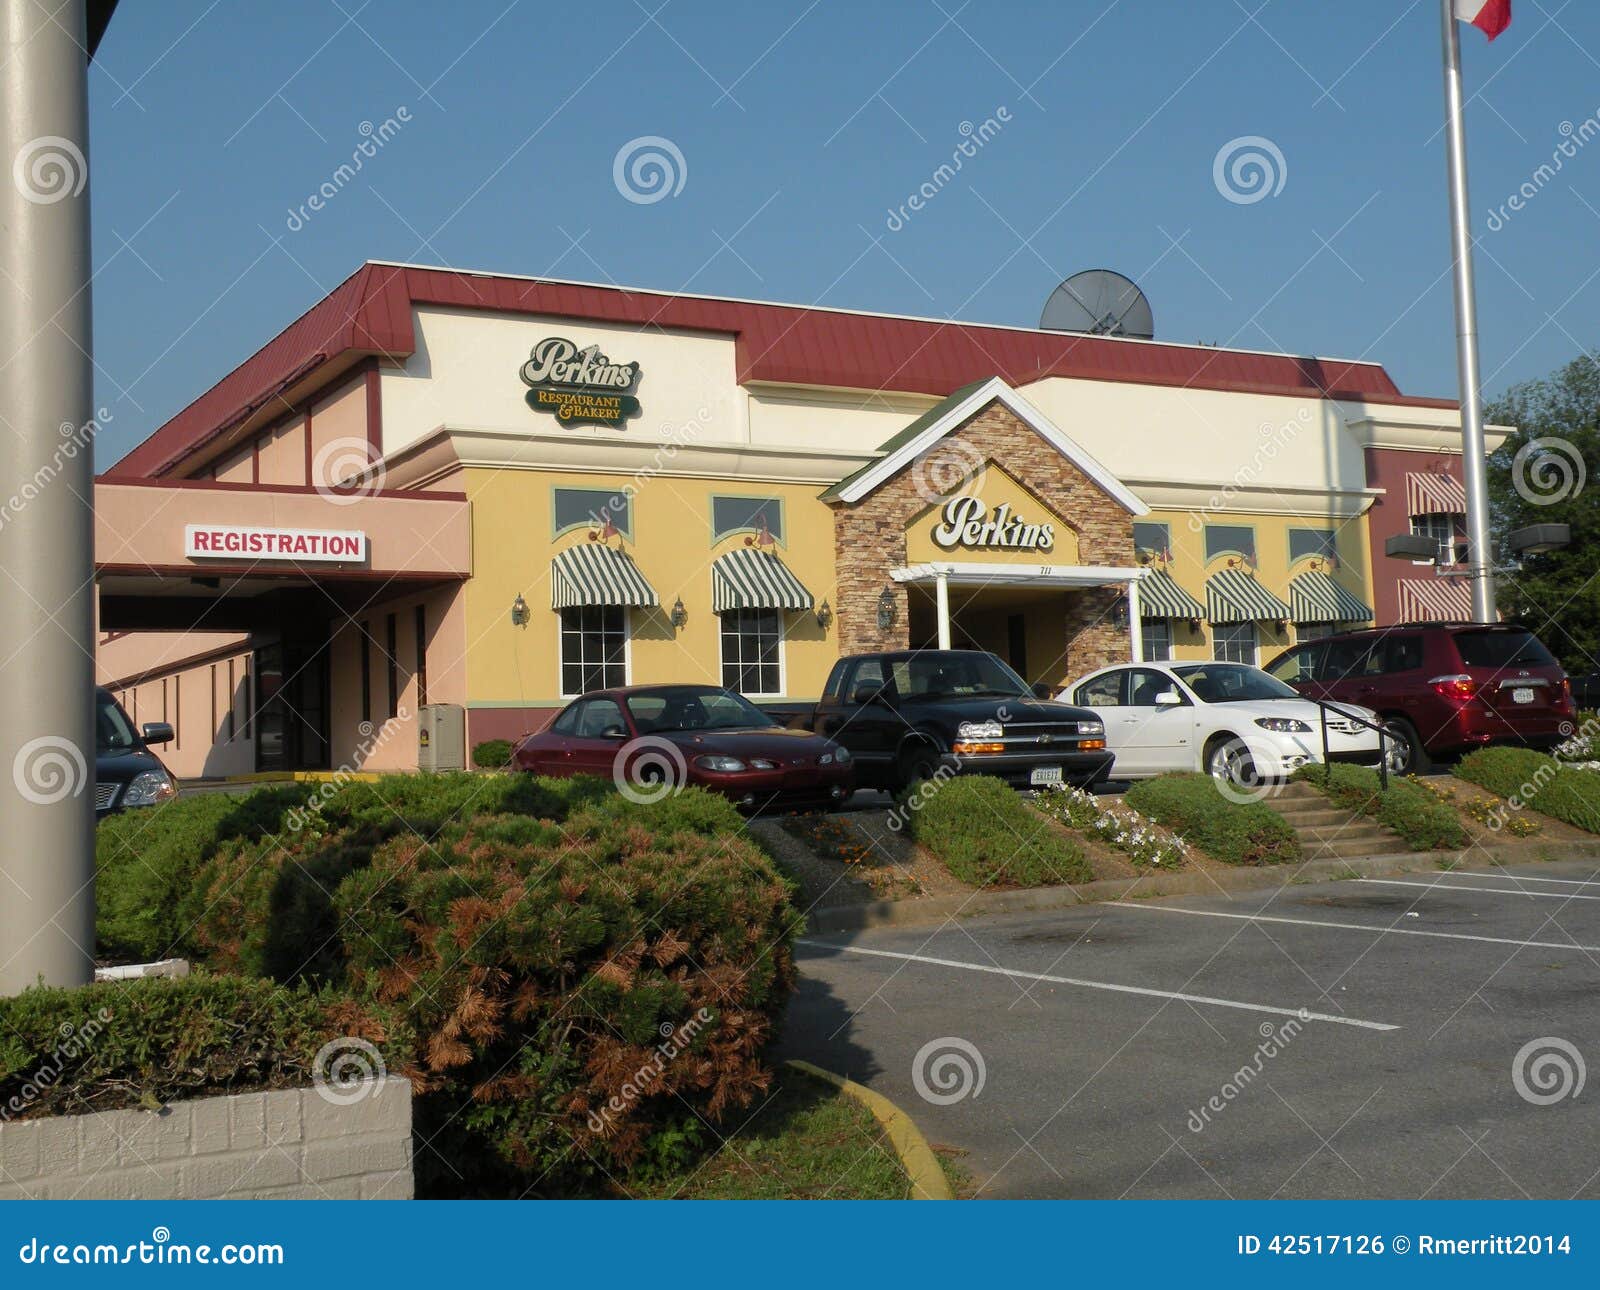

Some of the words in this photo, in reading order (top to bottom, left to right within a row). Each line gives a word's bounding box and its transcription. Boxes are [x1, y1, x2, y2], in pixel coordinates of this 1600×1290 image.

[524, 339, 633, 388] Perkins
[538, 391, 622, 408] RESTAURANT
[935, 496, 1055, 549] Perkins
[194, 531, 360, 556] REGISTRATION
